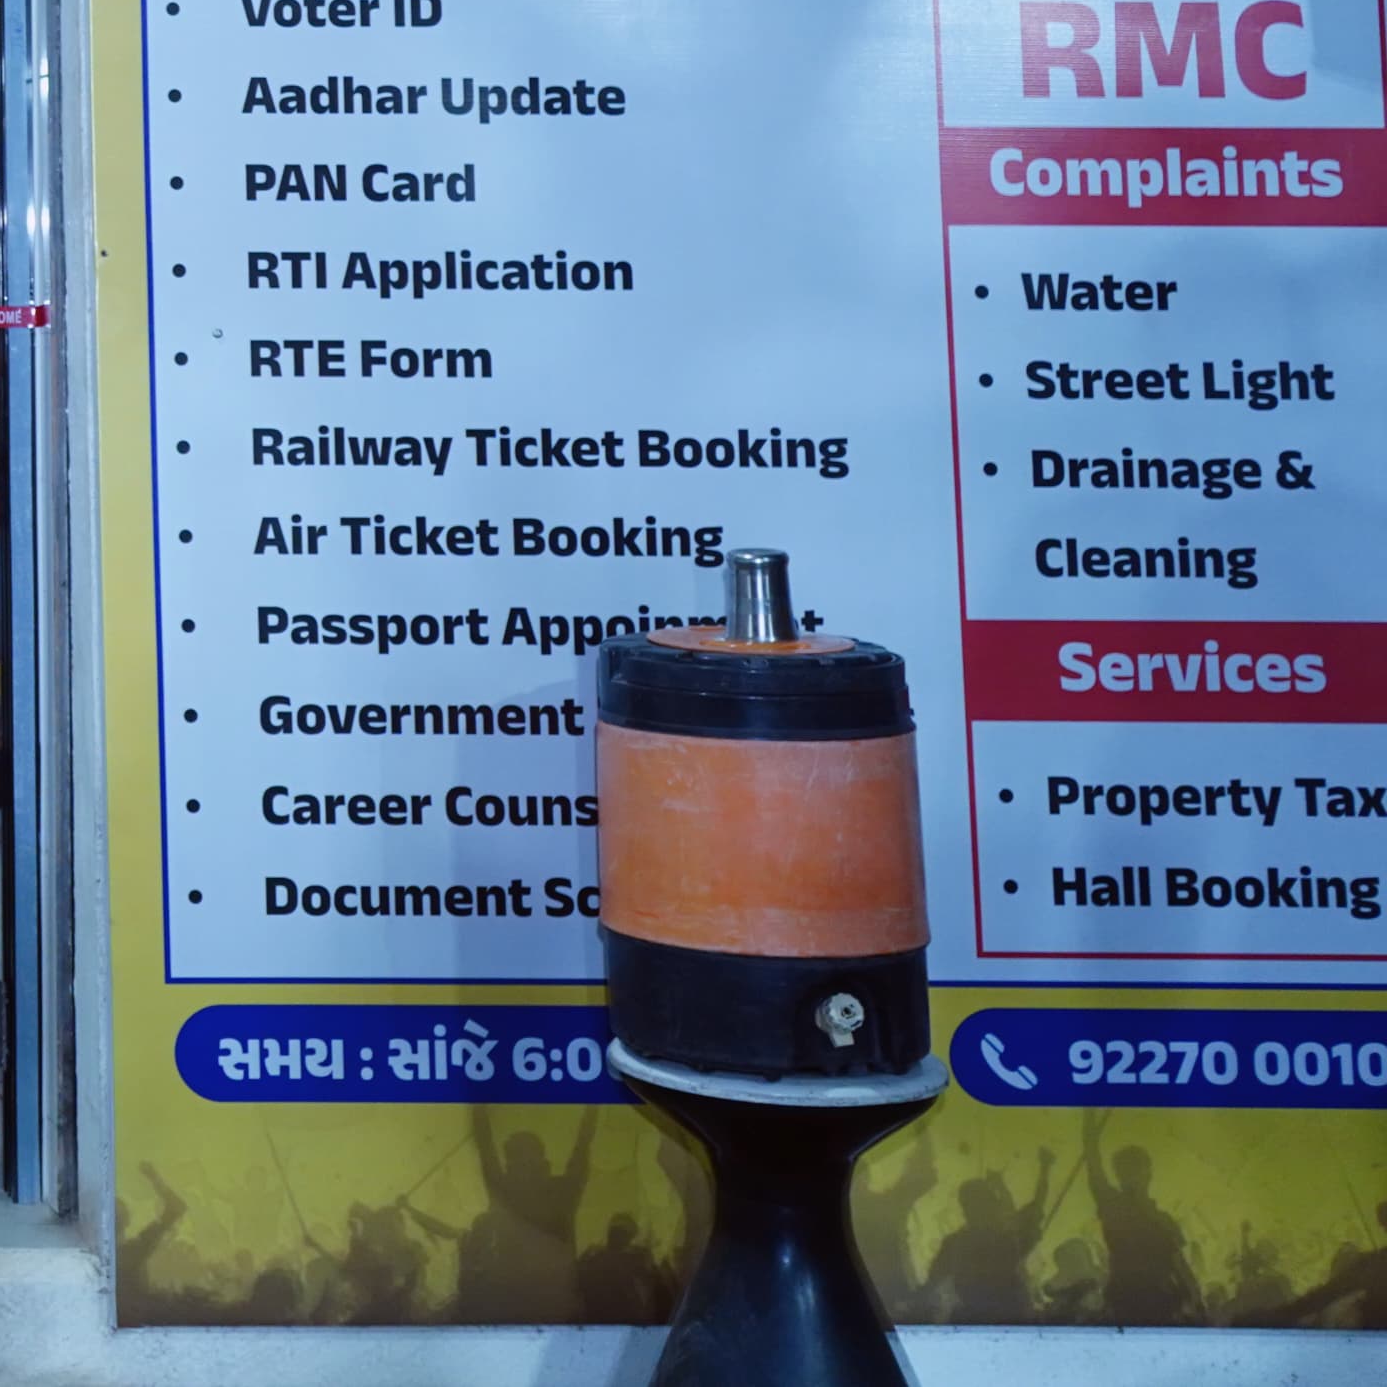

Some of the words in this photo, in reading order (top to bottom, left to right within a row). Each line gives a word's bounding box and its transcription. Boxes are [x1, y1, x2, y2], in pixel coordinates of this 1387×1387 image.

[1019, 0, 1307, 100] RMC
[242, 76, 428, 115] Aadhar
[440, 77, 627, 124] Update
[244, 163, 348, 202] PAN
[362, 163, 477, 202] Card
[989, 147, 1343, 207] Complaints
[247, 251, 328, 290] RTI
[342, 249, 634, 298] Application
[1021, 273, 1177, 312] Water
[249, 339, 347, 378] RTE
[360, 339, 493, 378] Form
[1025, 360, 1189, 400] Street
[1203, 359, 1335, 411] Light
[252, 426, 453, 475] Railway
[465, 426, 626, 468] Ticket
[638, 429, 850, 478] Booking
[1030, 448, 1262, 499] Drainage
[1275, 451, 1316, 490] &
[254, 515, 328, 556] Air
[340, 514, 499, 557] Ticket
[512, 516, 725, 567] Booking
[1034, 537, 1258, 589] Cleaning
[256, 604, 490, 655] Passport
[1058, 640, 1327, 693] Services
[259, 695, 584, 736] Government
[262, 785, 432, 826] Career
[1047, 776, 1282, 827] Property
[1294, 778, 1387, 818] Tax
[264, 876, 532, 917] Document
[1051, 866, 1152, 907] Hall
[1166, 866, 1382, 920] Booking
[218, 1039, 345, 1081] સમય
[387, 1019, 498, 1081] સાંજે
[1068, 1040, 1239, 1085] 92270
